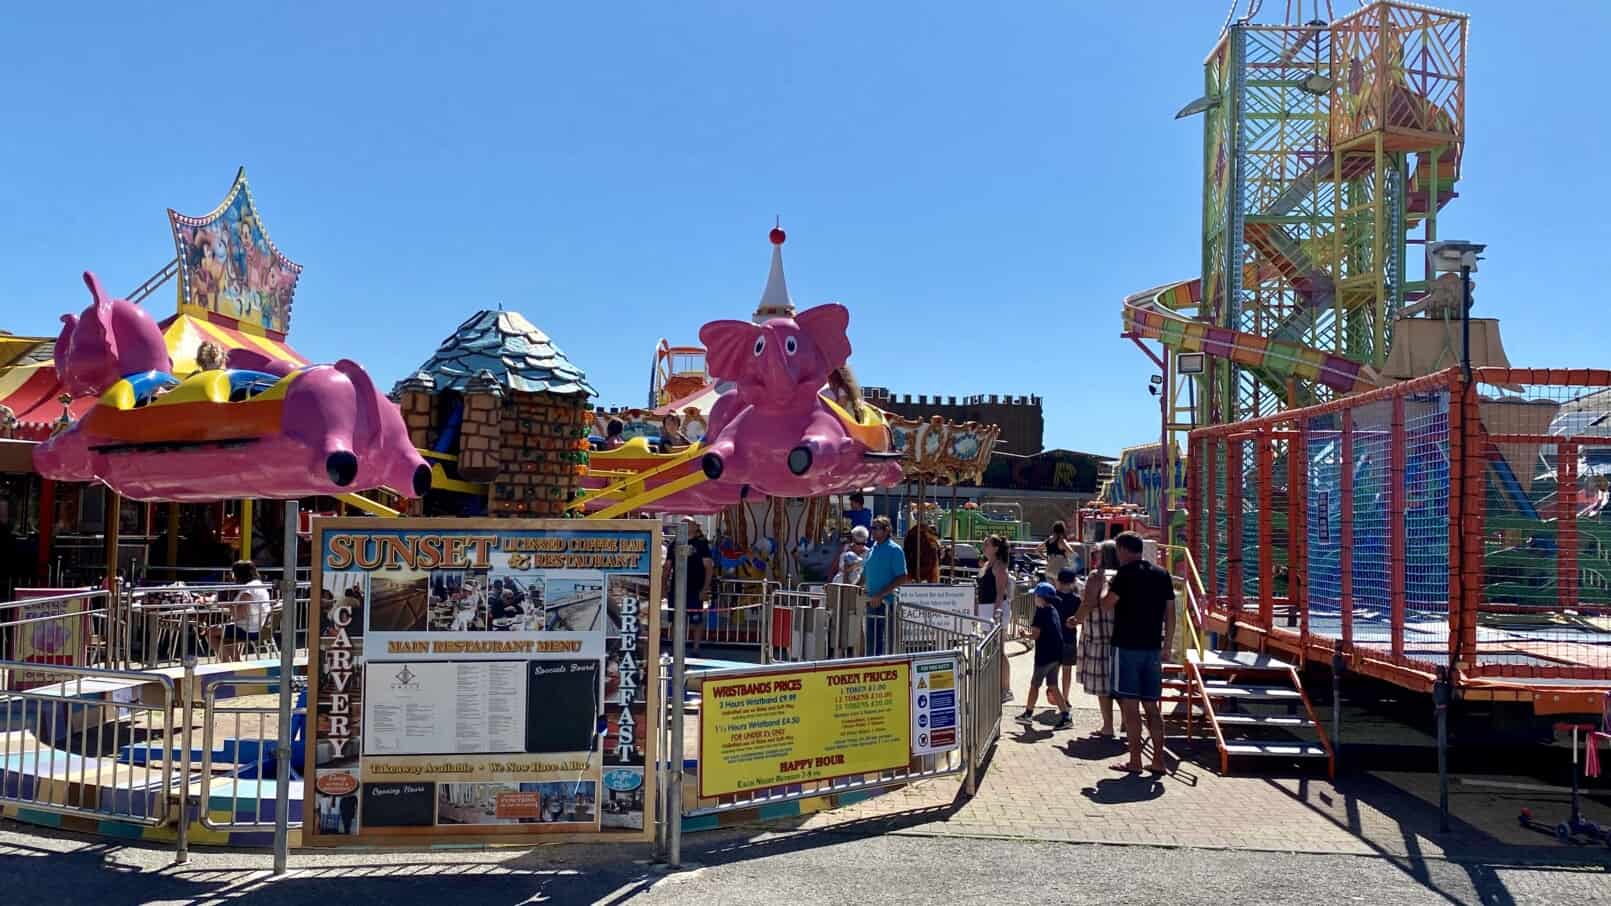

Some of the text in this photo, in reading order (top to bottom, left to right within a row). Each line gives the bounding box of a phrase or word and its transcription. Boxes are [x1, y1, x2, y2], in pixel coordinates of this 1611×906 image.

[328, 534, 497, 569] SUNSET
[502, 537, 645, 552] LICENSED COFFEE BAR
[508, 552, 641, 570] & RESTAURANT
[388, 640, 583, 653] MAIN RESTAURANT MENU
[570, 663, 595, 673] Board
[328, 606, 352, 758] CARVERY
[617, 597, 638, 763] BREAKFAST
[826, 669, 898, 687] TOKEN PRICES
[712, 679, 802, 698] WRISTBANDS PRICES
[779, 754, 845, 773] HAPPY HOUR
[371, 784, 425, 797] Opening Hours
